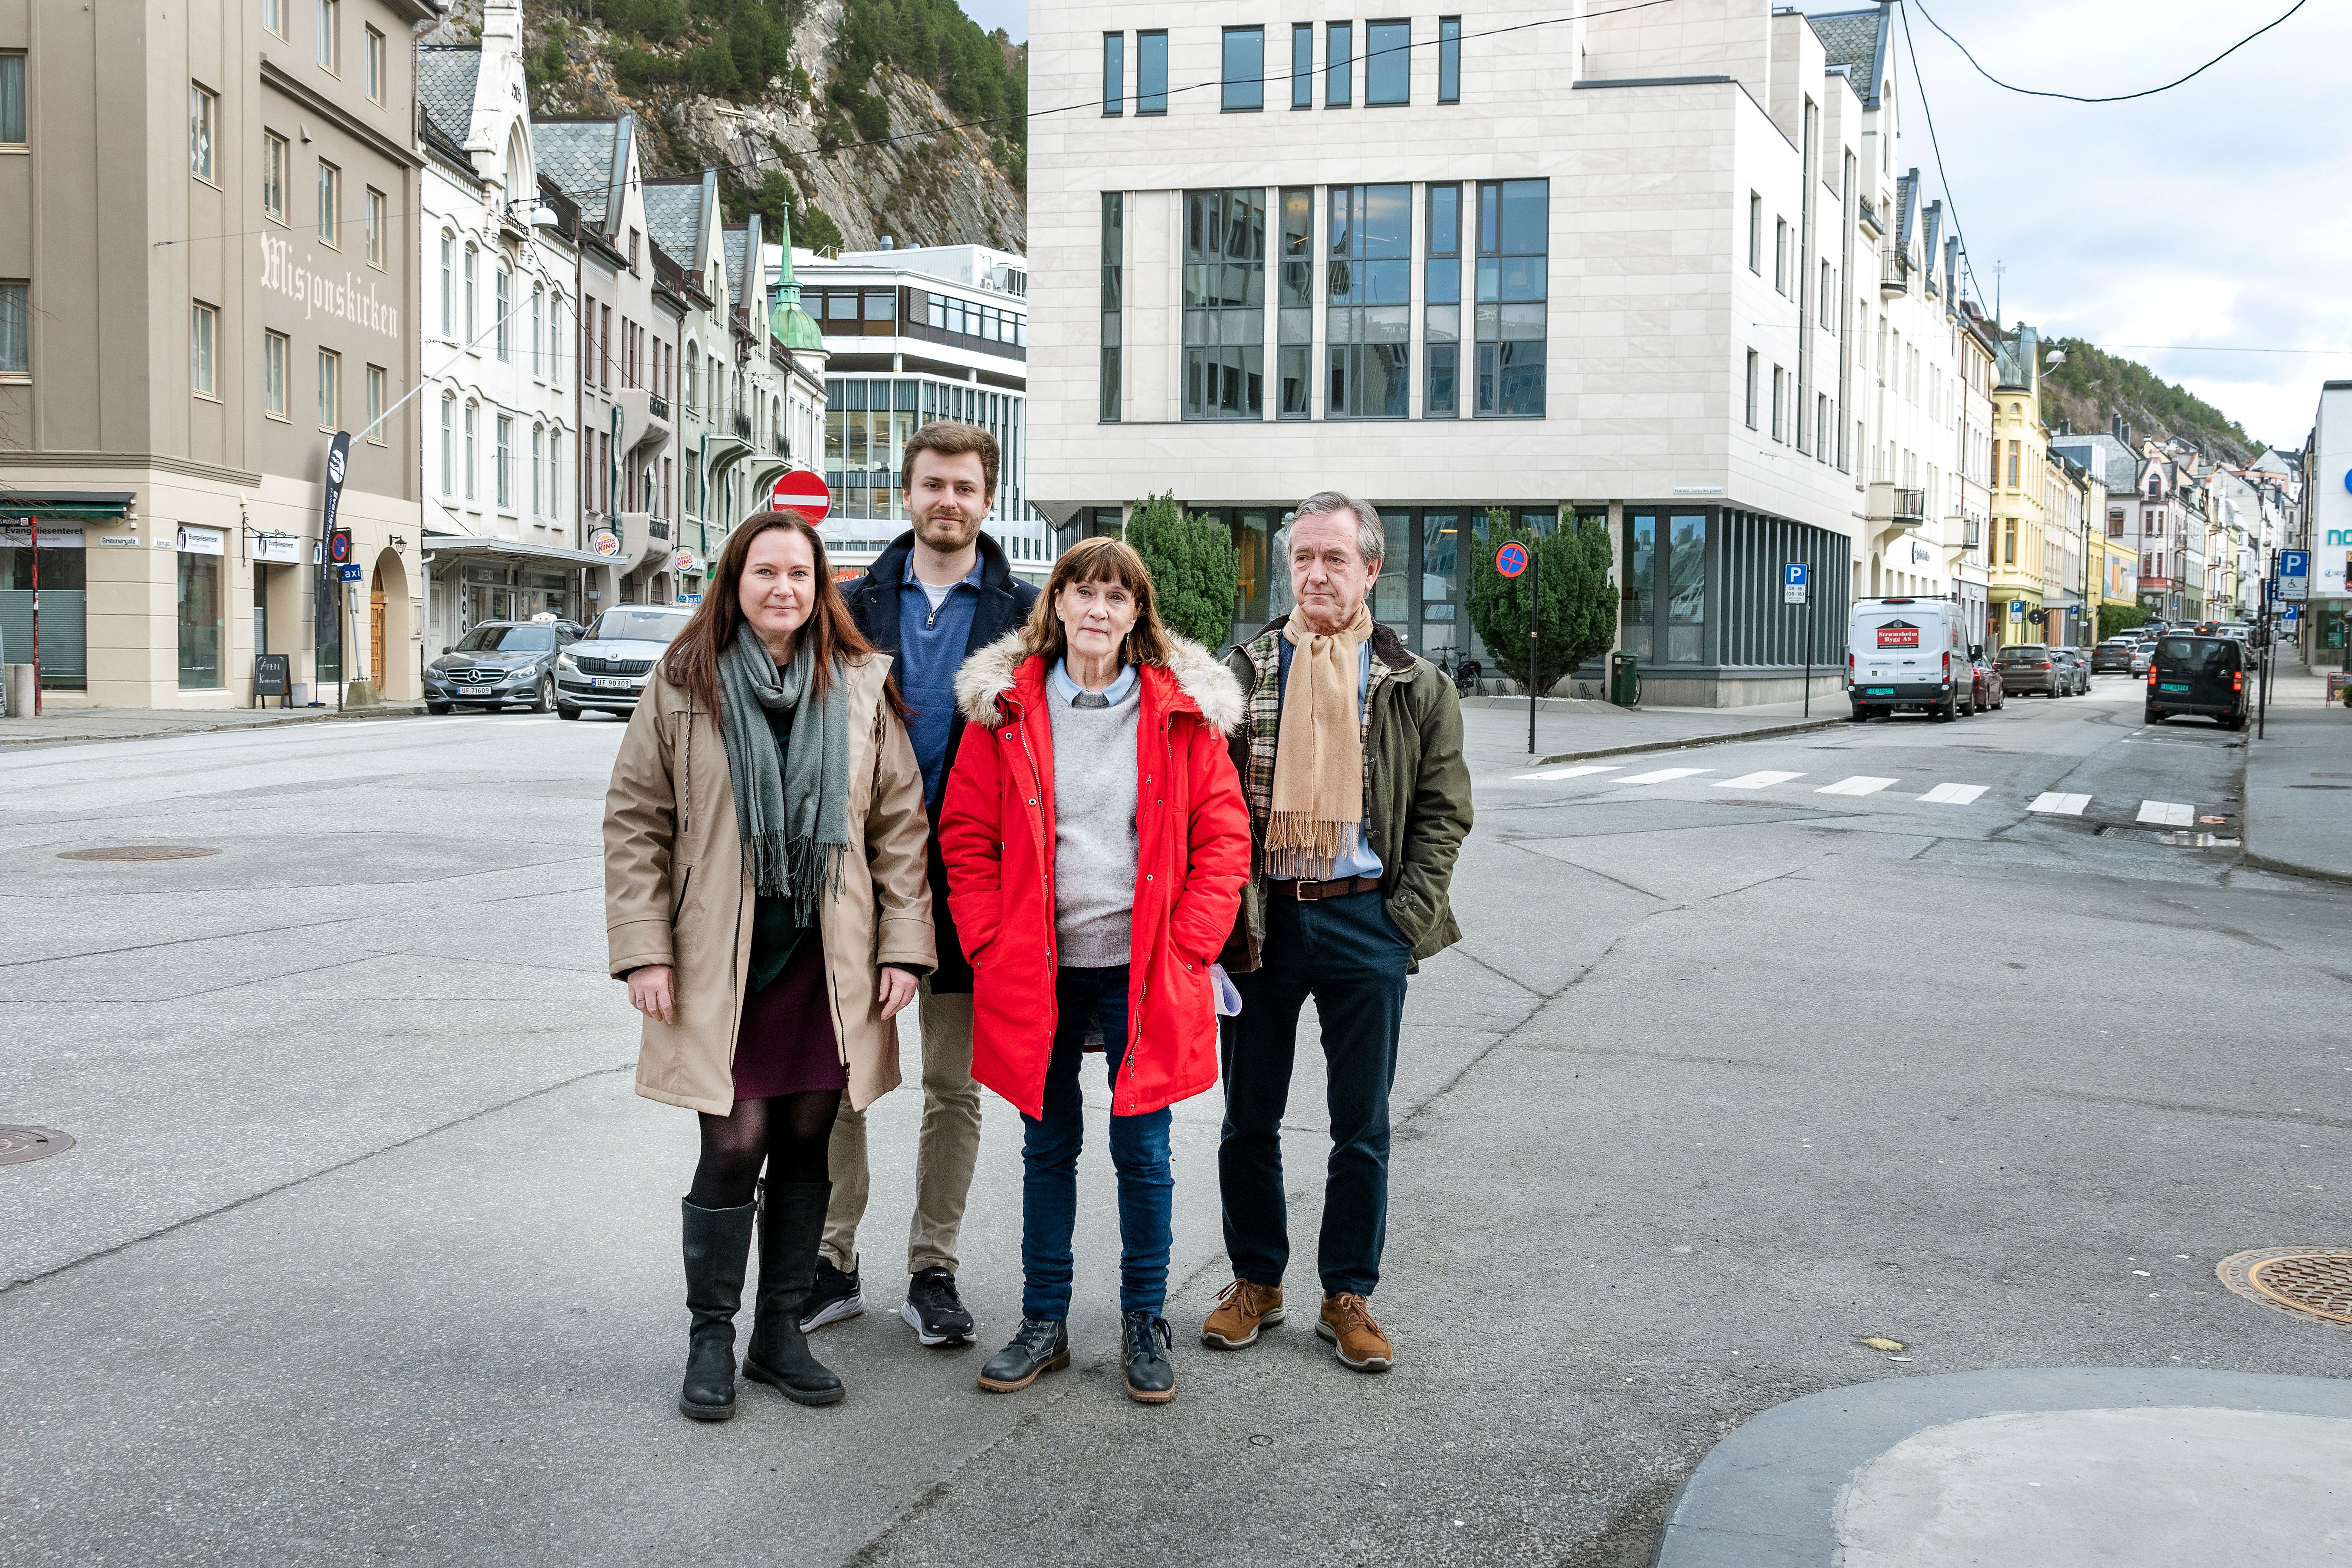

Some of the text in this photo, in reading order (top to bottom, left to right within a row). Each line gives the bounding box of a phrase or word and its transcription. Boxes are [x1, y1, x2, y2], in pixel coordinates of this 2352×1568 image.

[261, 229, 398, 338] Misjonskirken
[5, 527, 83, 535] Evangliesenteret
[597, 542, 616, 552] KING
[2286, 555, 2301, 573] P
[345, 567, 361, 578] axi
[1791, 567, 1801, 582] P
[2014, 603, 2020, 611] P
